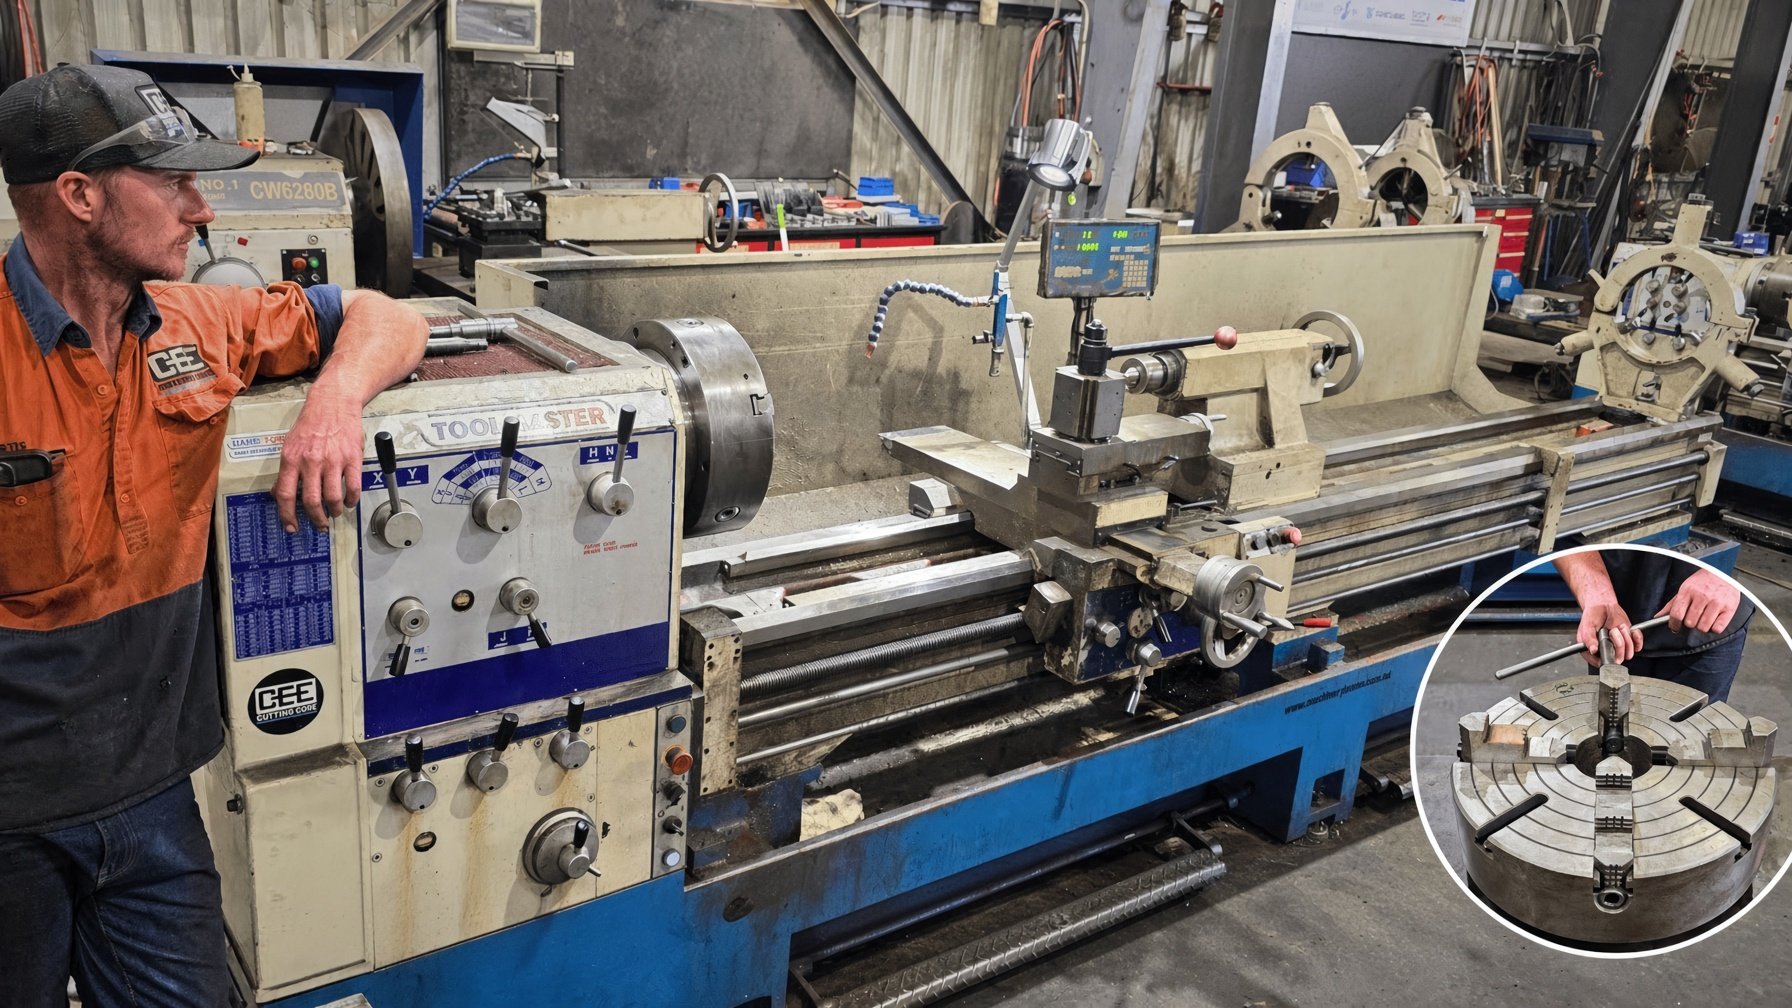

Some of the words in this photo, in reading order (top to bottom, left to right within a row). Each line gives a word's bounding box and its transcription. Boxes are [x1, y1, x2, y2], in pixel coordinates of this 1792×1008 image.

[250, 180, 338, 200] CW6280B
[147, 346, 205, 380] CEE
[589, 447, 598, 458] H
[606, 446, 614, 456] N
[373, 472, 383, 484] X
[407, 468, 418, 480] Y
[500, 631, 507, 642] J
[258, 681, 315, 711] CEE
